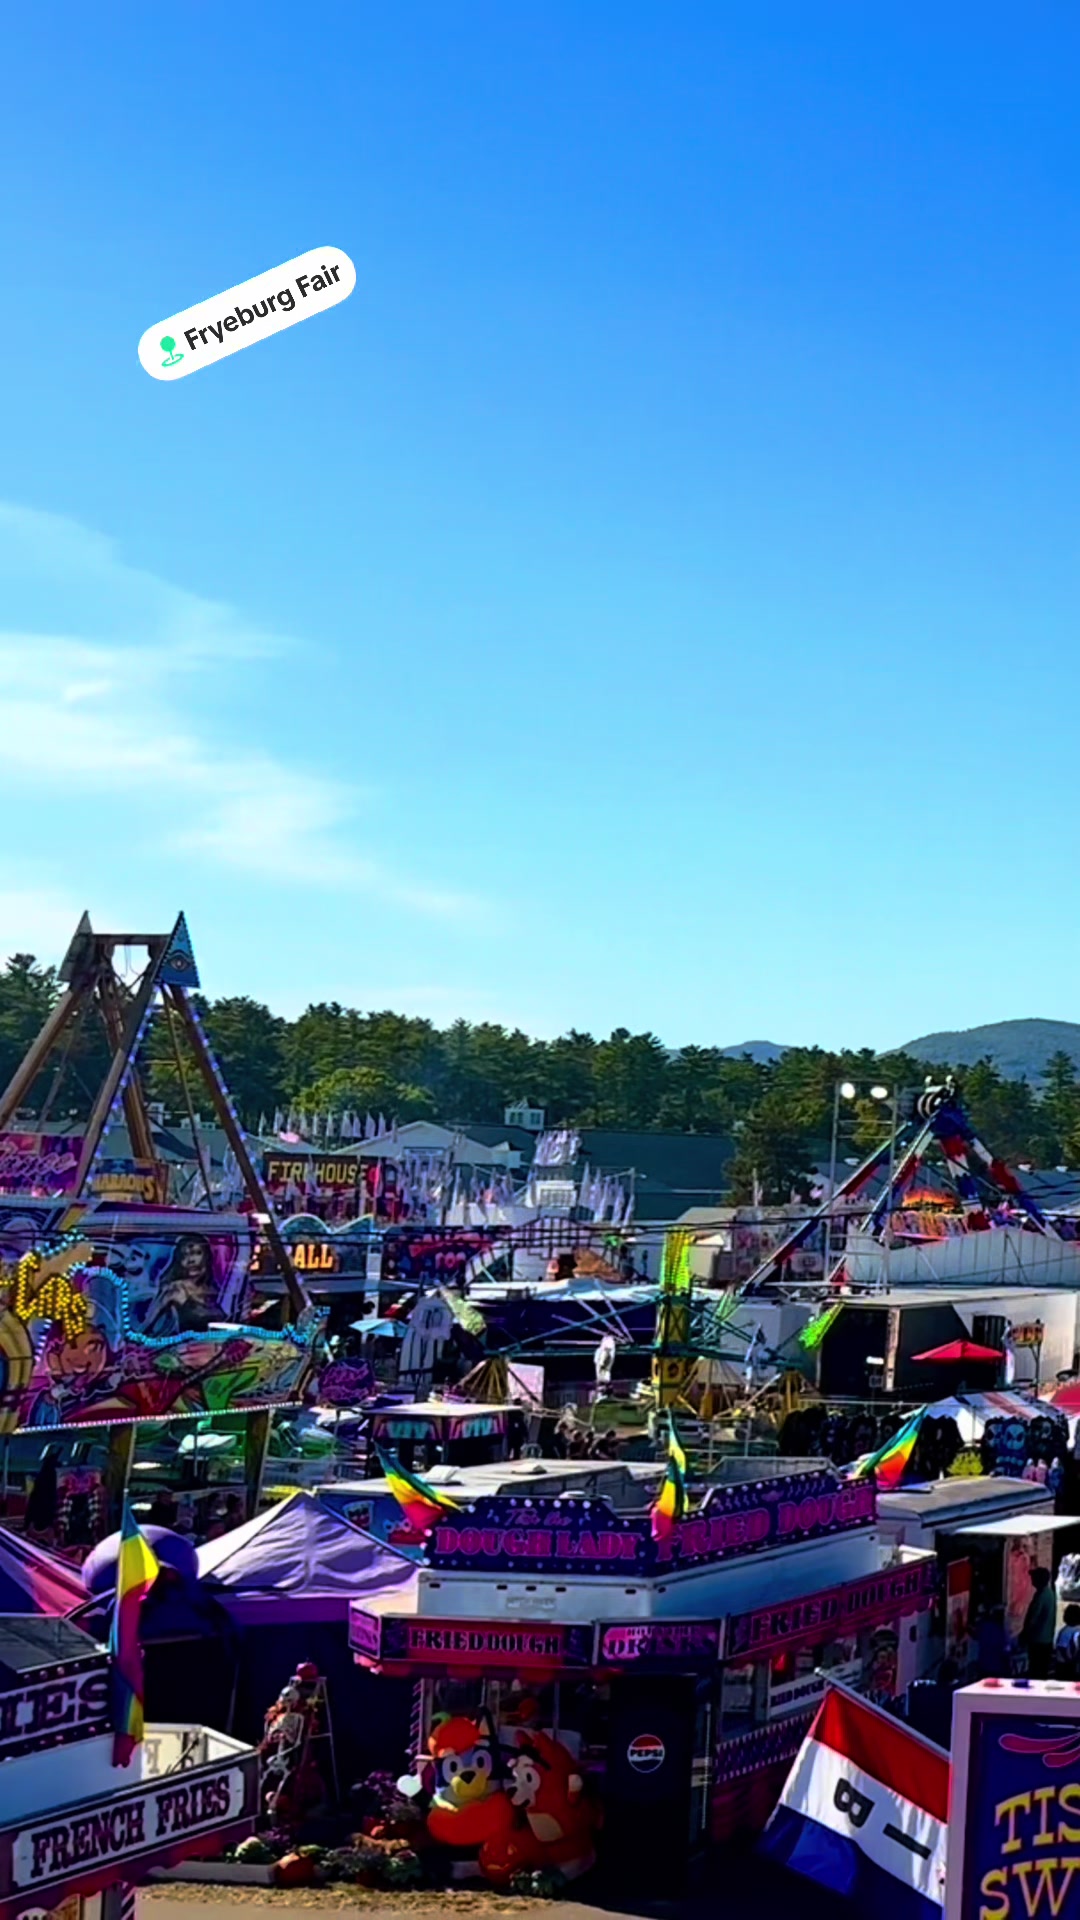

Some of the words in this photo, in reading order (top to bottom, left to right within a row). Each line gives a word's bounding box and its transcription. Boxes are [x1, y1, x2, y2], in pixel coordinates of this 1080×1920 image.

[267, 1161, 368, 1184] FIRHOUSE
[277, 1243, 334, 1270] ALL
[776, 1485, 876, 1535] DOUGH
[434, 1526, 553, 1557] DOUGH
[554, 1529, 642, 1560] LADY
[752, 1597, 839, 1643] FRIED
[409, 1625, 483, 1652] FRIED
[484, 1629, 561, 1656] DOUGH
[630, 1749, 664, 1758] PEPSI
[30, 1801, 146, 1878] FRENCH
[156, 1775, 231, 1836] FRIES
